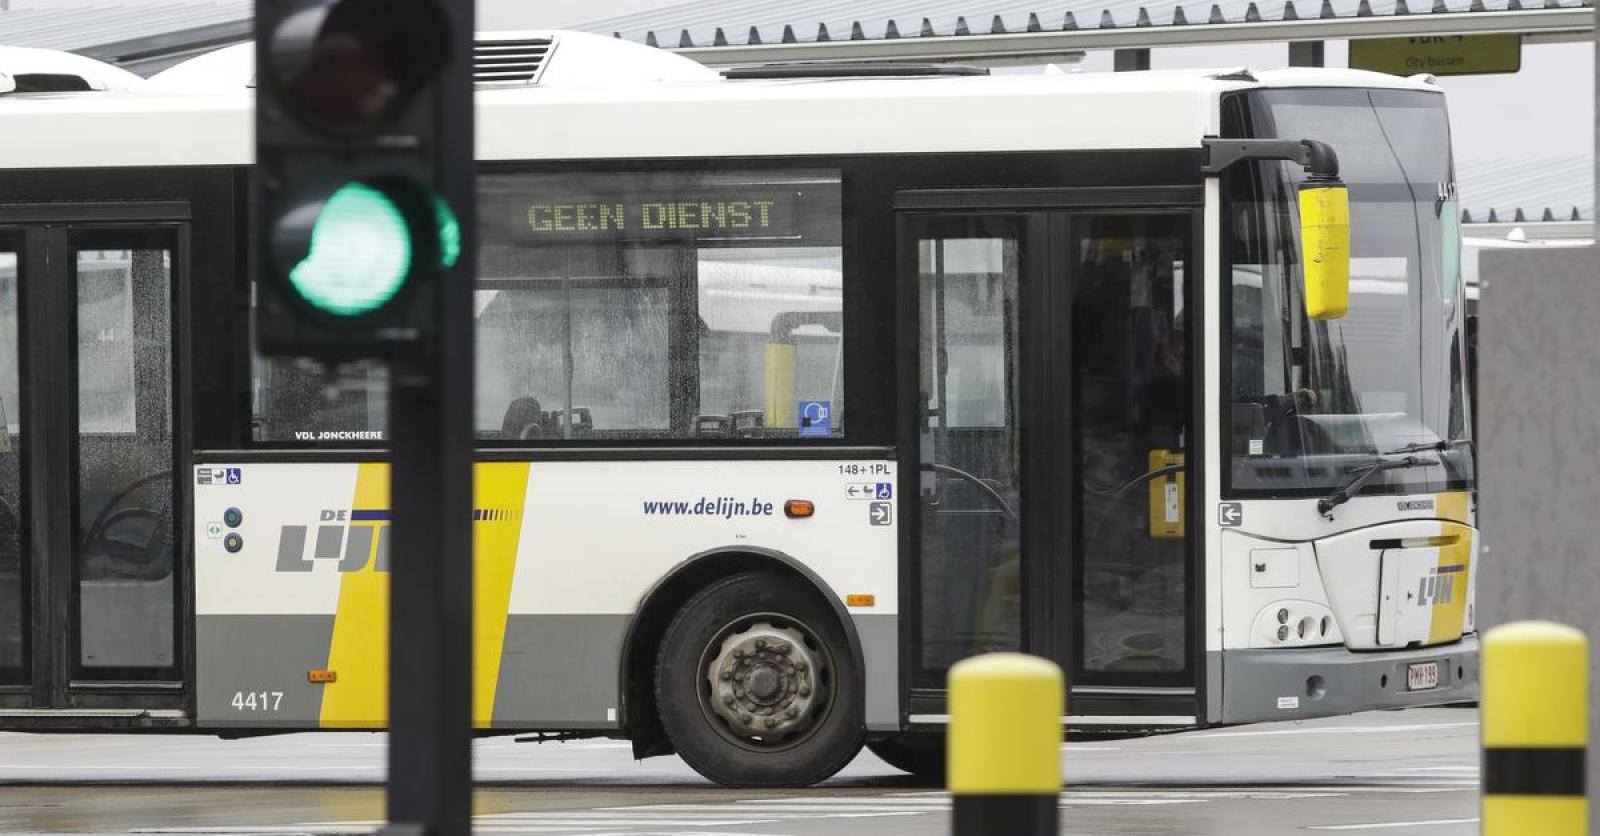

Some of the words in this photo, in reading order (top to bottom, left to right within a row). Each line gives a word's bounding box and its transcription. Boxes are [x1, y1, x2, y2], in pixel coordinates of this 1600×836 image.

[527, 203, 625, 232] GEEN
[640, 200, 775, 229] DIENST
[294, 431, 315, 440] VDL
[318, 431, 384, 440] JONCKHEERE
[838, 464, 891, 475] 148+1PL
[320, 509, 348, 521] DE
[643, 496, 773, 519] www.delijn.be
[231, 691, 284, 711] 4417
